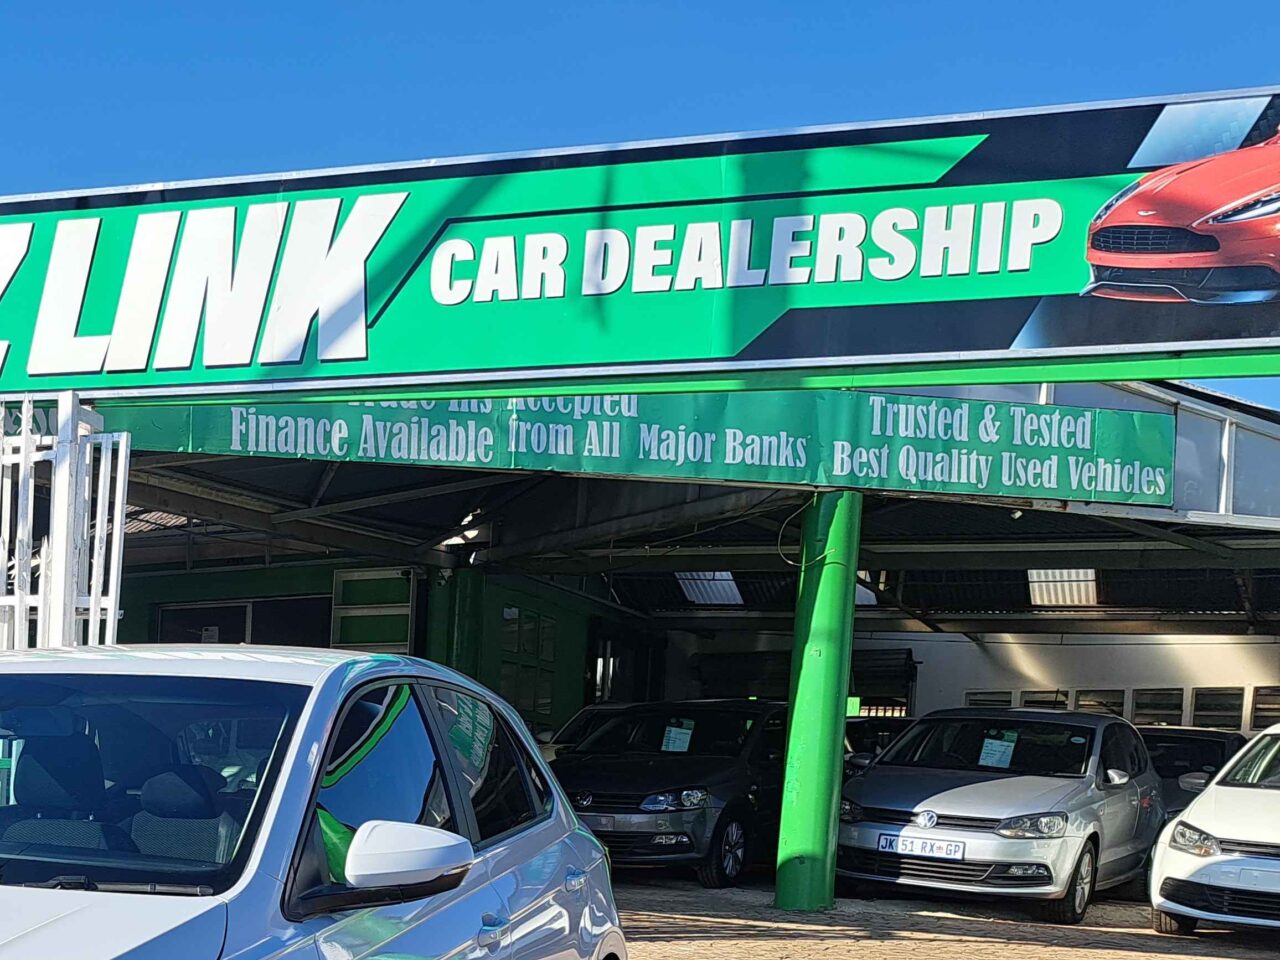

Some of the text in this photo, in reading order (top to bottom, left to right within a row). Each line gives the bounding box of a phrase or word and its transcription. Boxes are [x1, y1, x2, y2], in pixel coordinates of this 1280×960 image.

[430, 198, 1063, 305] CAR DEALERSHIP
[26, 192, 410, 376] LINK
[230, 407, 807, 468] Finance Available from All Major Banks
[869, 396, 1092, 449] Trusted & Tested
[832, 440, 1165, 495] Best Quality Used Vehicles
[881, 837, 960, 856] JK 51 RX GP
